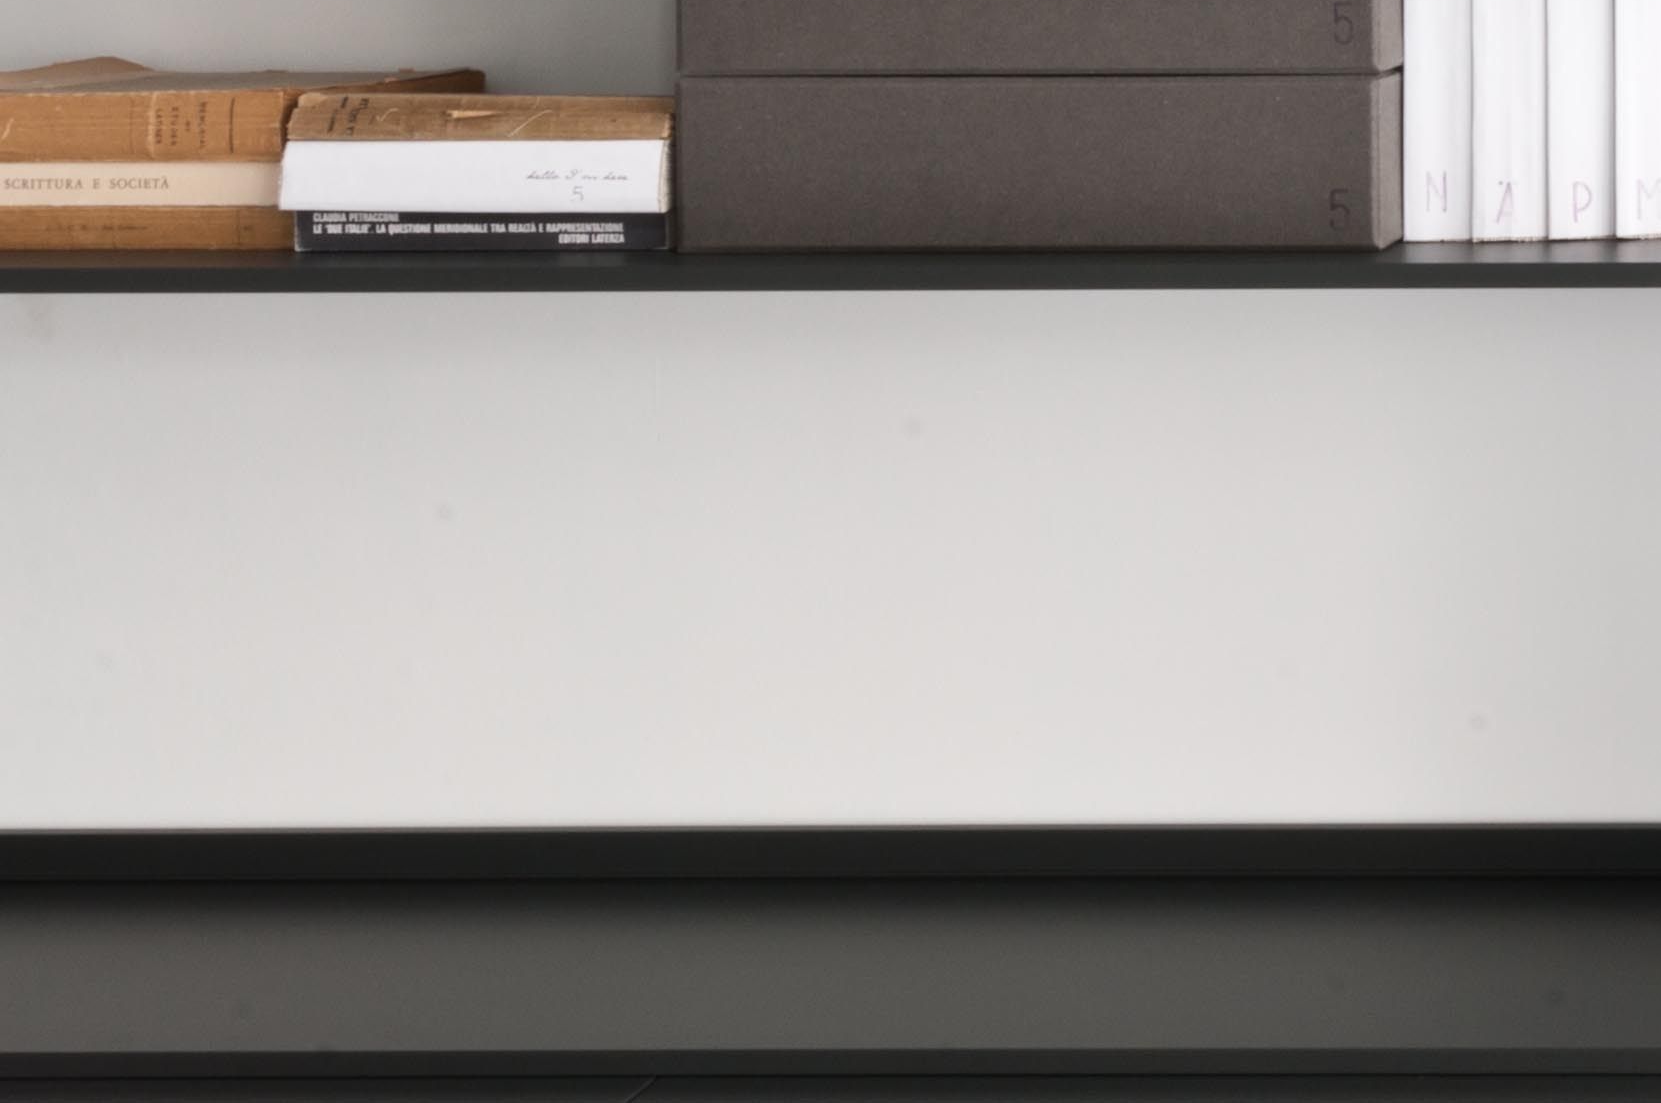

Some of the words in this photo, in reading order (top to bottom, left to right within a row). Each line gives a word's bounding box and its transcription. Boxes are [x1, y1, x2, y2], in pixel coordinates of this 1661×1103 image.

[1332, 0, 1354, 46] 5
[3, 177, 83, 190] SCRITTURA
[92, 178, 102, 189] E
[108, 175, 170, 190] SOCIETÀ
[1425, 170, 1448, 214] N
[1571, 180, 1594, 224] P
[1328, 187, 1351, 231] 5
[591, 233, 625, 245] LATERZA
